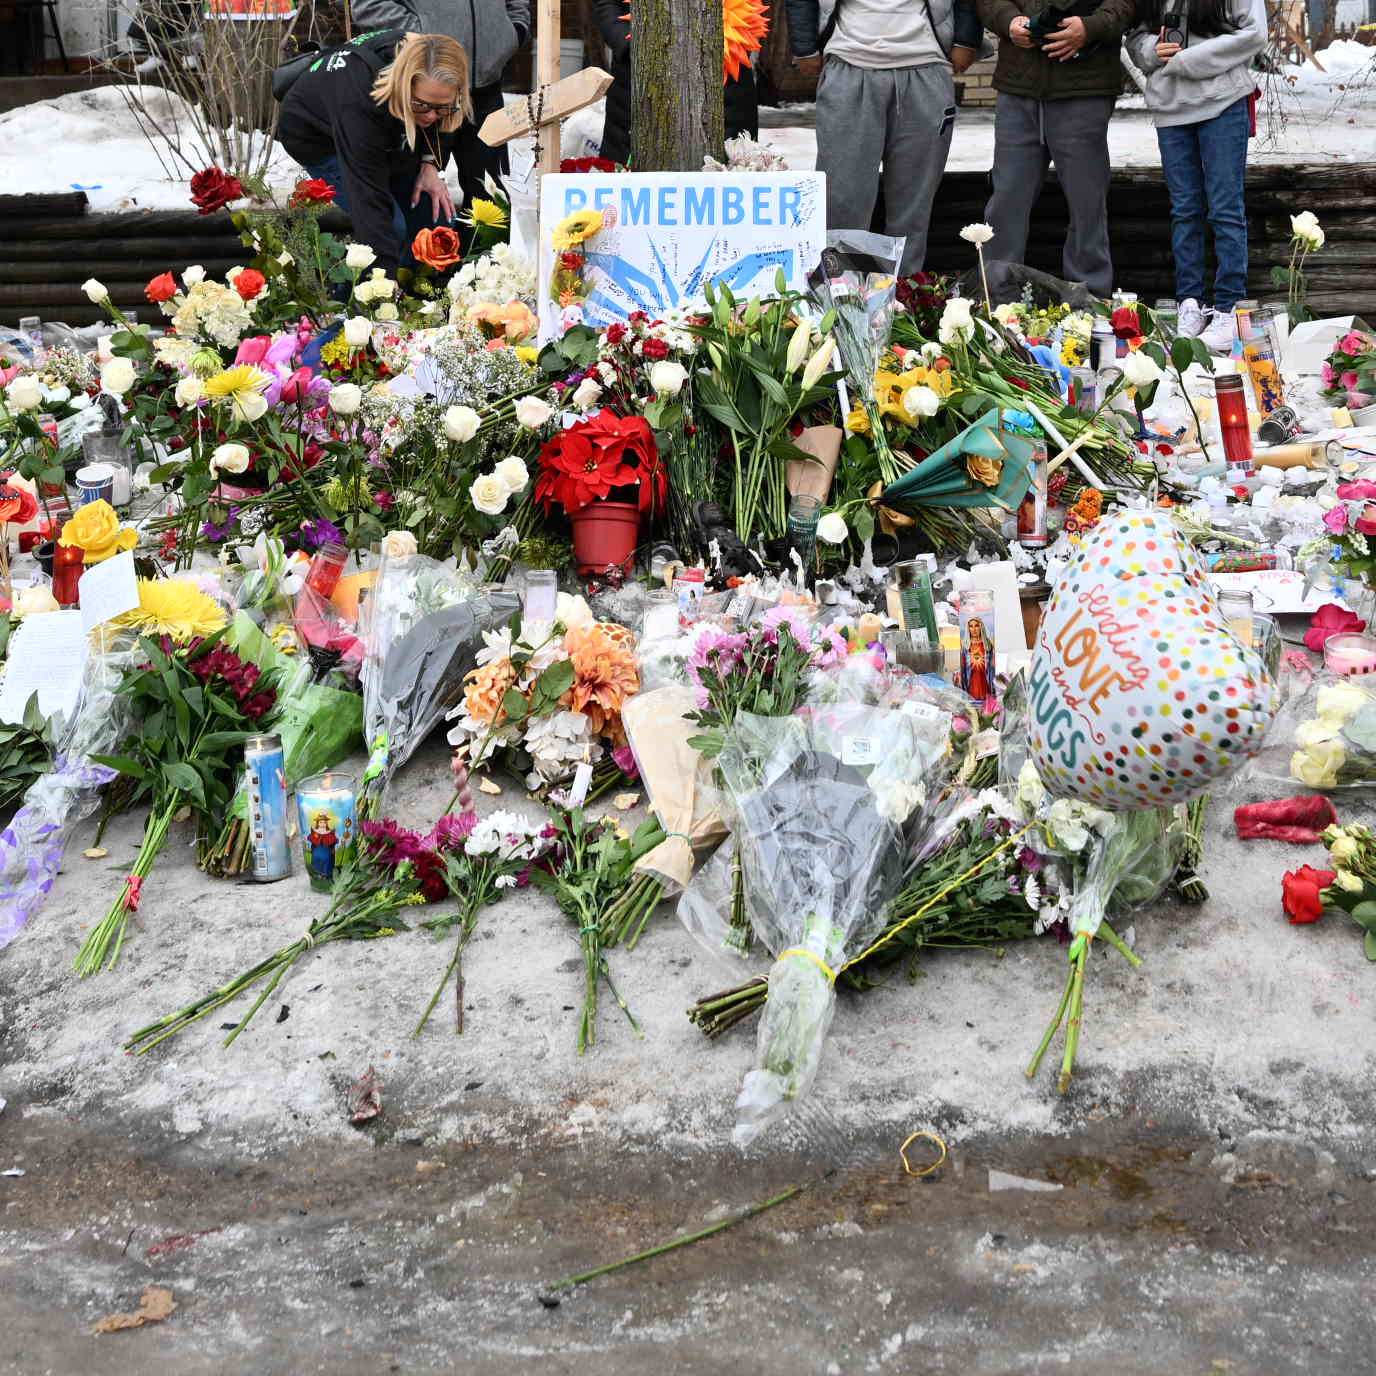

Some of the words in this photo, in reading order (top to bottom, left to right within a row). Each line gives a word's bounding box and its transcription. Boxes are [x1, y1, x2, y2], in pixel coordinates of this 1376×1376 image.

[565, 186, 802, 226] REMEMBER
[1052, 666, 1085, 711] and
[1054, 608, 1110, 715] LOVE
[1078, 583, 1151, 691] sending
[1030, 657, 1084, 768] HUGS
